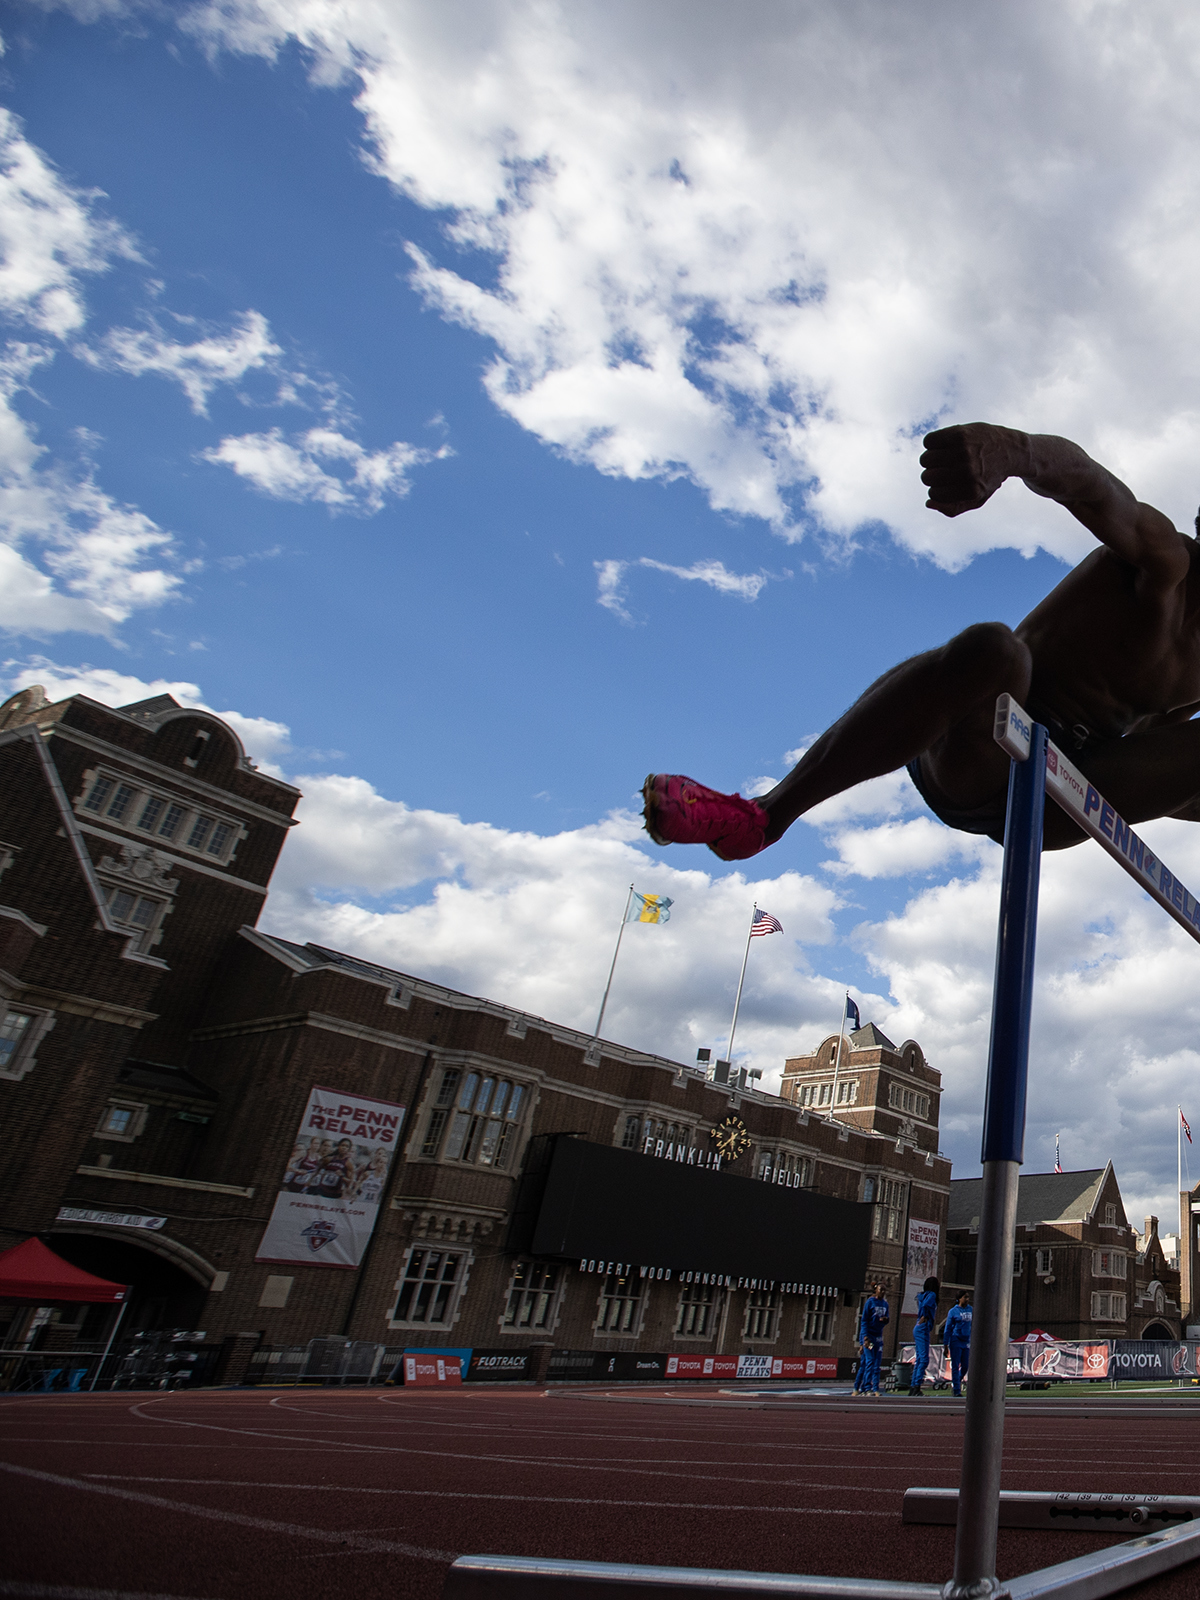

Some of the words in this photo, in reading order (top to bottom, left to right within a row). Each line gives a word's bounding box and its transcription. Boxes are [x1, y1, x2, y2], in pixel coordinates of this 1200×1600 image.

[1059, 764, 1084, 798] TOYOTA
[1083, 783, 1145, 871] PENN
[311, 1104, 336, 1116] THE
[337, 1105, 399, 1128] PENN
[308, 1115, 395, 1142] RELAYS
[643, 1137, 722, 1171] FRANKLIN
[763, 1166, 801, 1189] FIELD
[290, 1201, 365, 1216] PENNRELAYS.COM
[918, 1226, 938, 1237] PENN
[910, 1233, 938, 1246] RELAYS
[579, 1258, 632, 1277] ROBERT
[640, 1265, 672, 1281] WOOD
[679, 1270, 731, 1288] JOHNSON
[737, 1276, 775, 1291] FAMILY
[780, 1282, 839, 1298] SCOREBOARD
[478, 1356, 528, 1366] FLOTRACK
[678, 1362, 701, 1370] TOYOTA
[714, 1362, 736, 1370] TOYOTA
[743, 1357, 768, 1366] PENN
[816, 1363, 837, 1371] TOYOTA
[1114, 1353, 1162, 1368] TOYOTA
[416, 1364, 436, 1375] TOYOTA
[736, 1367, 771, 1377] RELAYS
